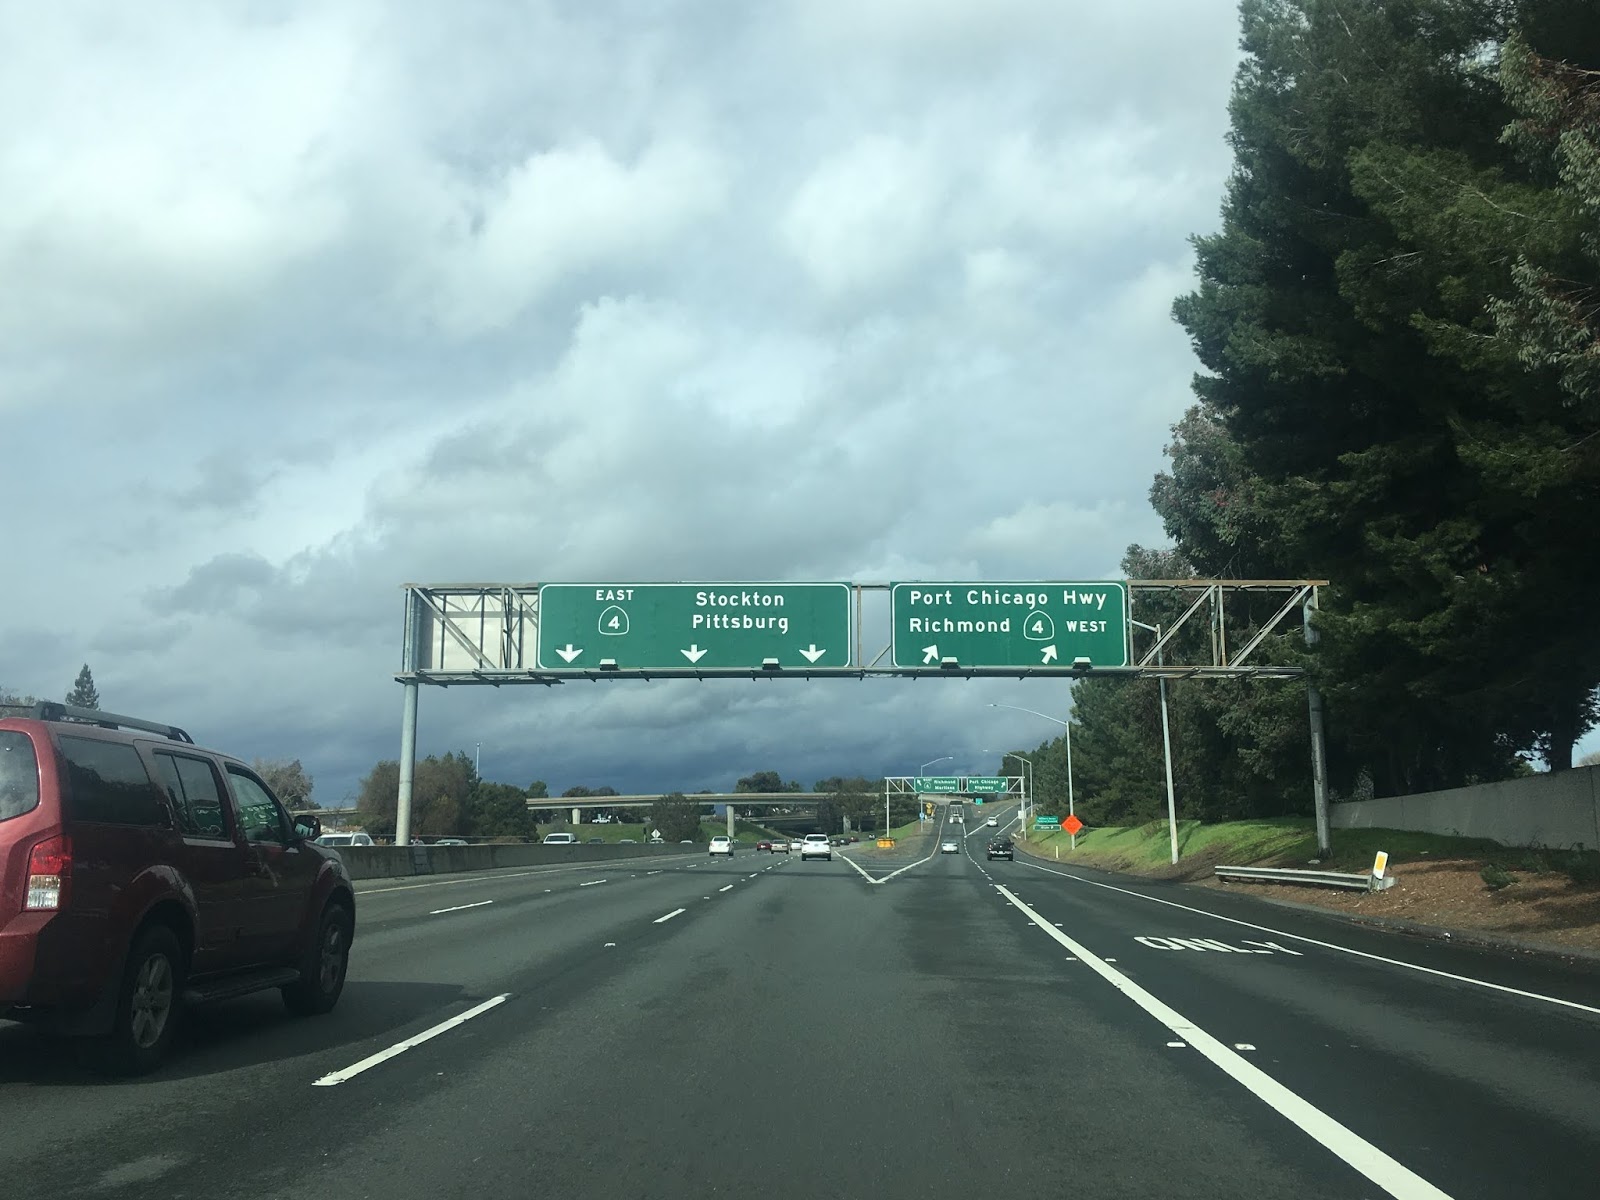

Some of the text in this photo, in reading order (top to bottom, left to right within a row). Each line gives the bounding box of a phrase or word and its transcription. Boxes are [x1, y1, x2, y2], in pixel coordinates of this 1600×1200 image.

[596, 589, 634, 601] EAST
[695, 591, 785, 607] Stockton
[910, 589, 1107, 611] Port Chicago Hwy
[607, 615, 620, 630] 4
[692, 613, 789, 635] Pittsburg
[909, 617, 1107, 634] Richmond 4 WEST
[1133, 936, 1304, 956] ONLY
